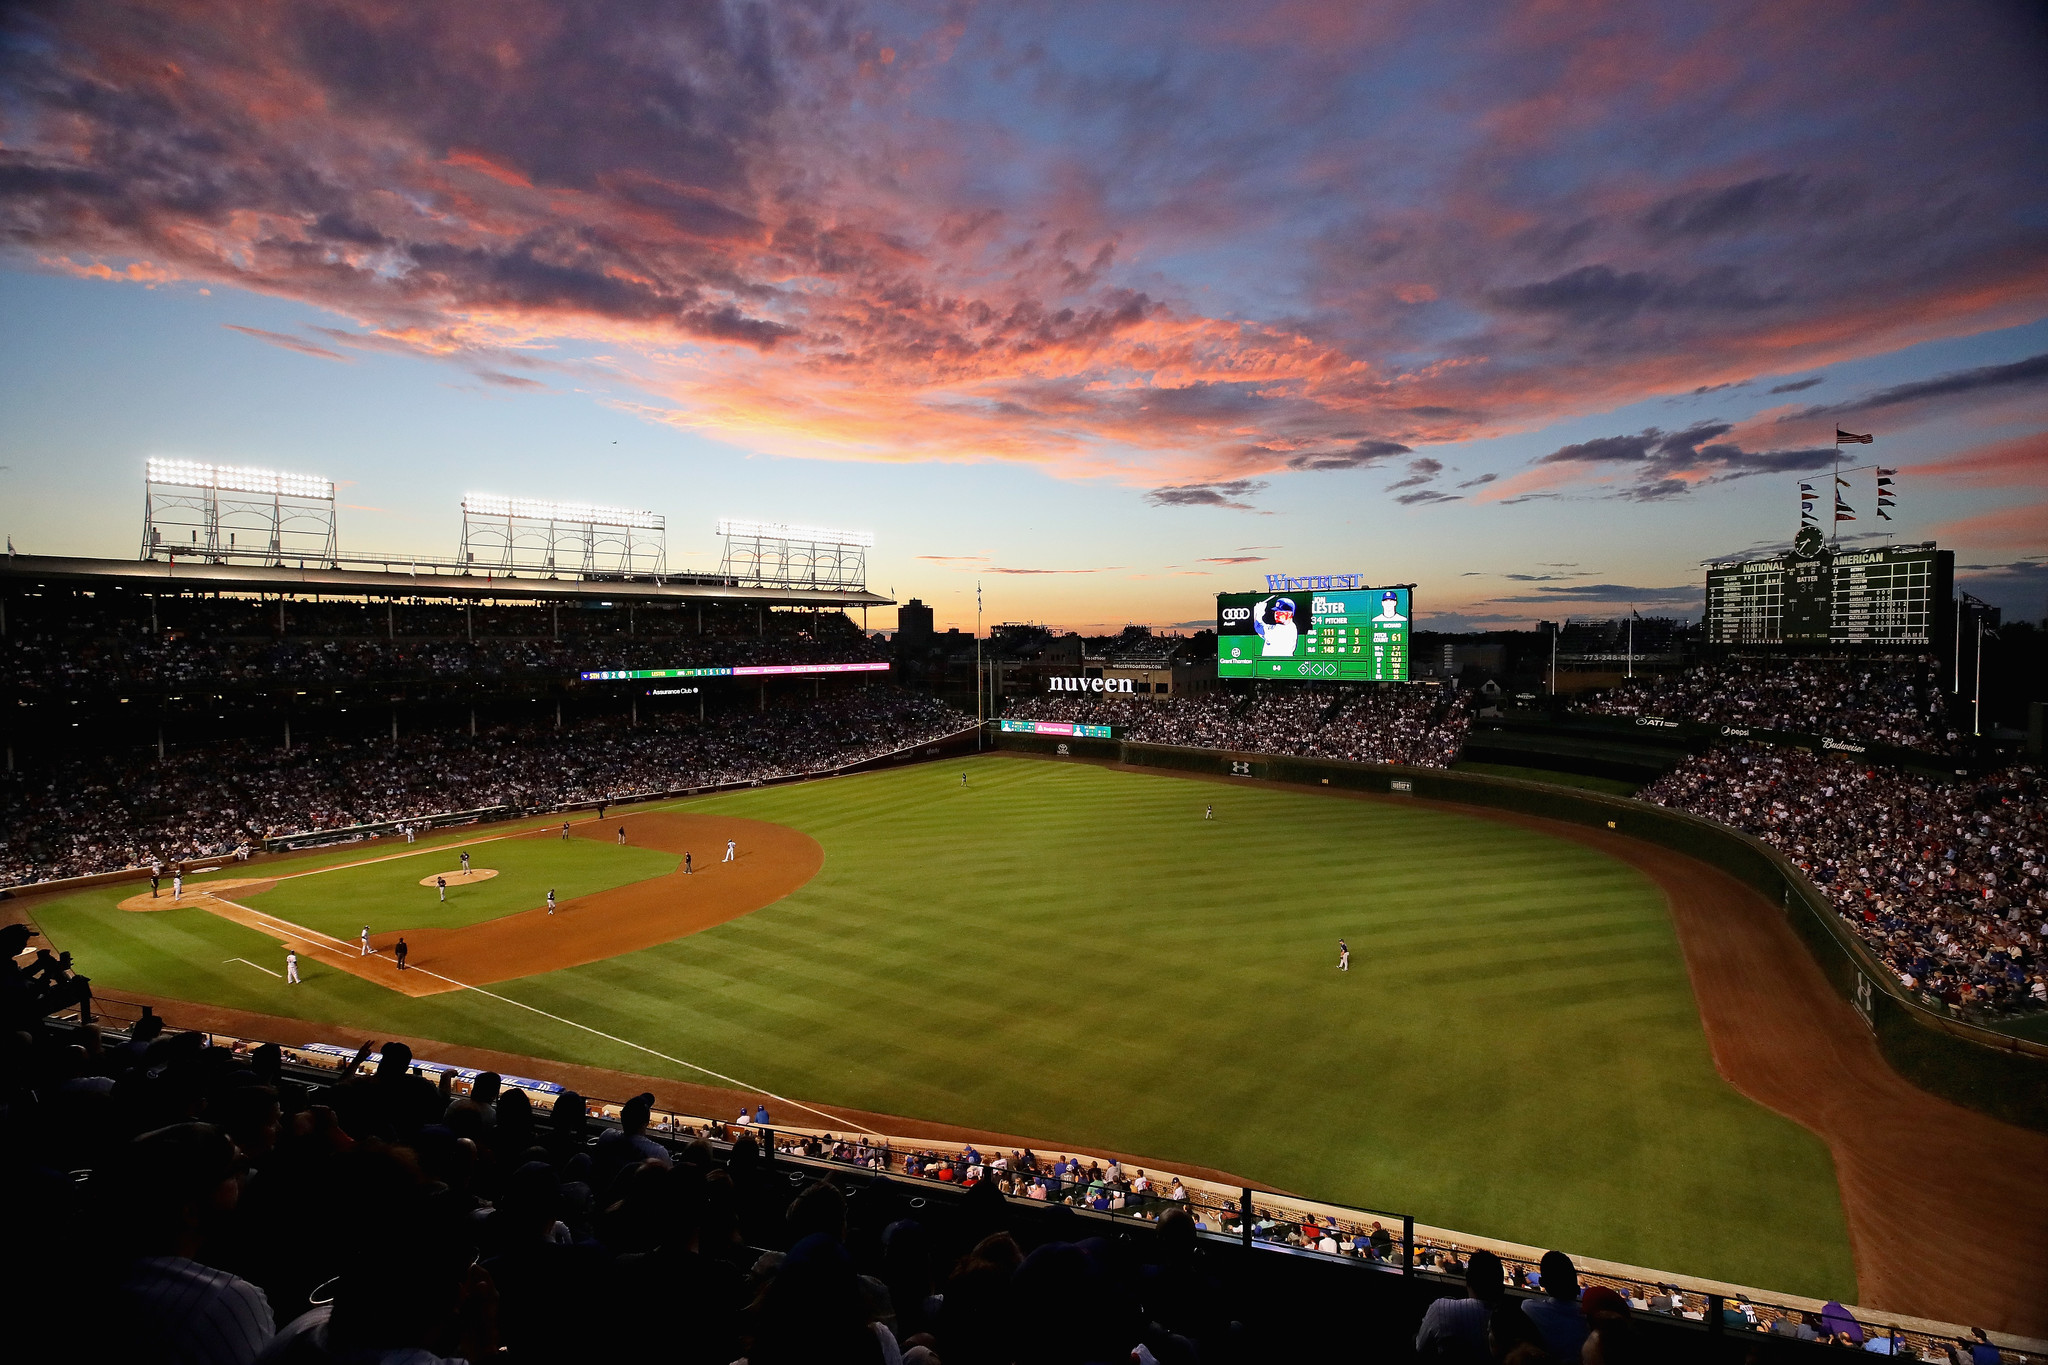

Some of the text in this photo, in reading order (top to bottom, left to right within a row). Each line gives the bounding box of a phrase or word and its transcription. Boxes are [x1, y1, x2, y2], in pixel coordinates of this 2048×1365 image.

[1832, 553, 1883, 565] AMERICAN
[1743, 562, 1784, 573] NATIONAL
[1264, 573, 1364, 591] WINTRUST
[1800, 584, 1814, 592] 34
[1312, 602, 1345, 614] LESTER
[1311, 616, 1322, 625] 34
[1050, 676, 1133, 693] nuveen
[1731, 728, 1749, 737] pepsi
[1822, 737, 1865, 752] Budweiser
